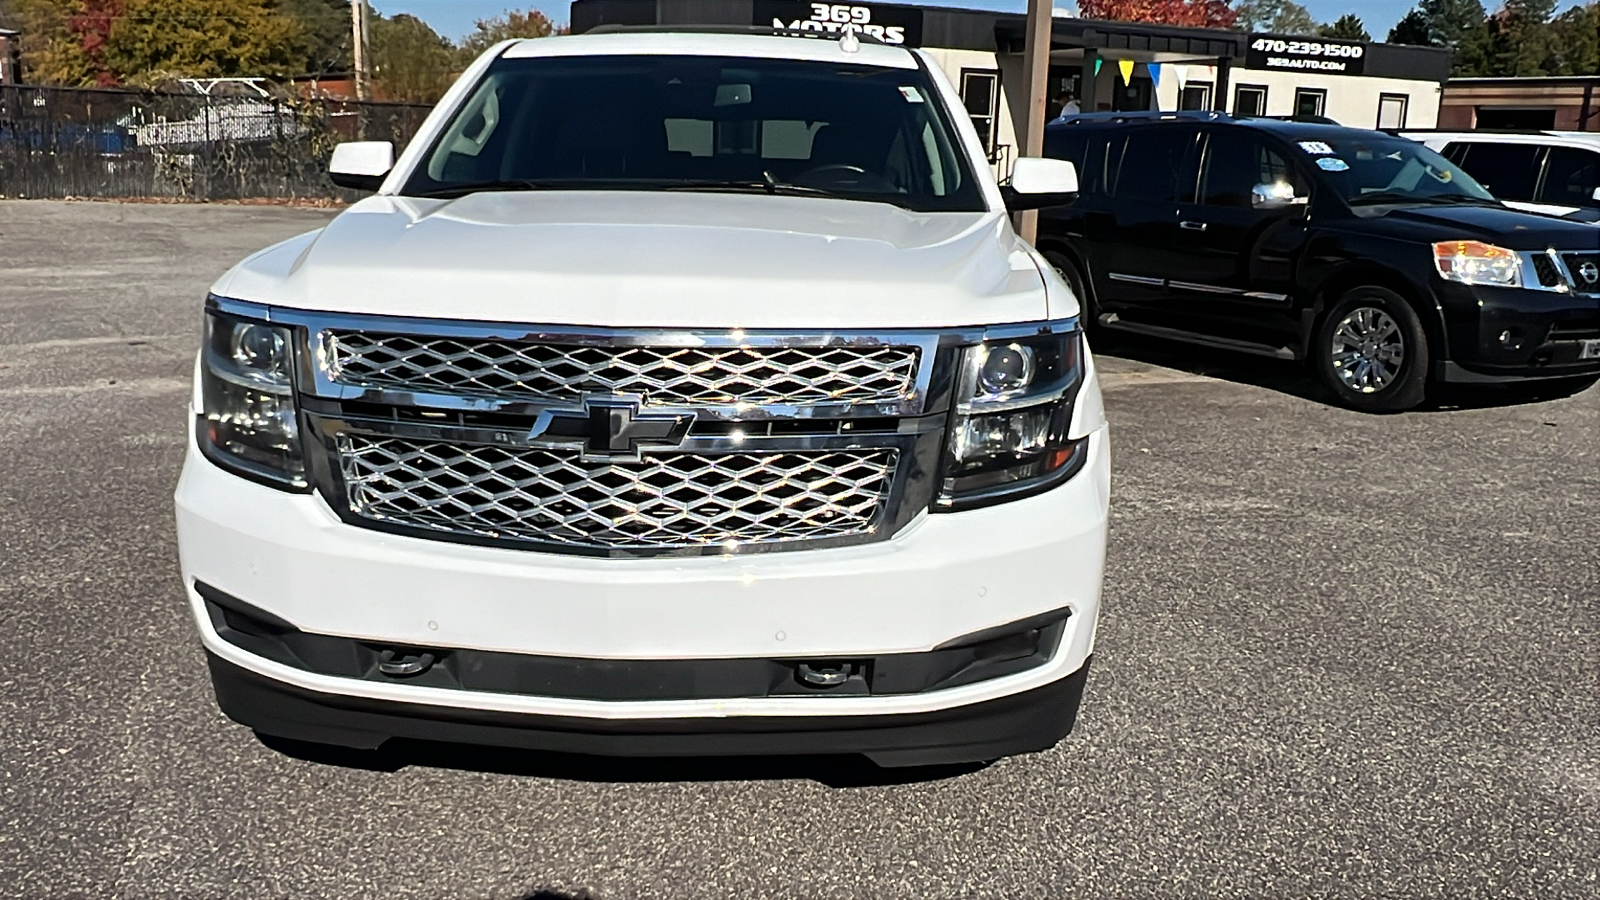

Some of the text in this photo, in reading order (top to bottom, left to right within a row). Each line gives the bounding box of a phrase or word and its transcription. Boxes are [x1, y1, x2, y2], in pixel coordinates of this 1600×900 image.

[810, 3, 871, 24] 369
[1251, 39, 1363, 58] 470-239-1500
[1266, 57, 1346, 71] 369AUTO.COM
